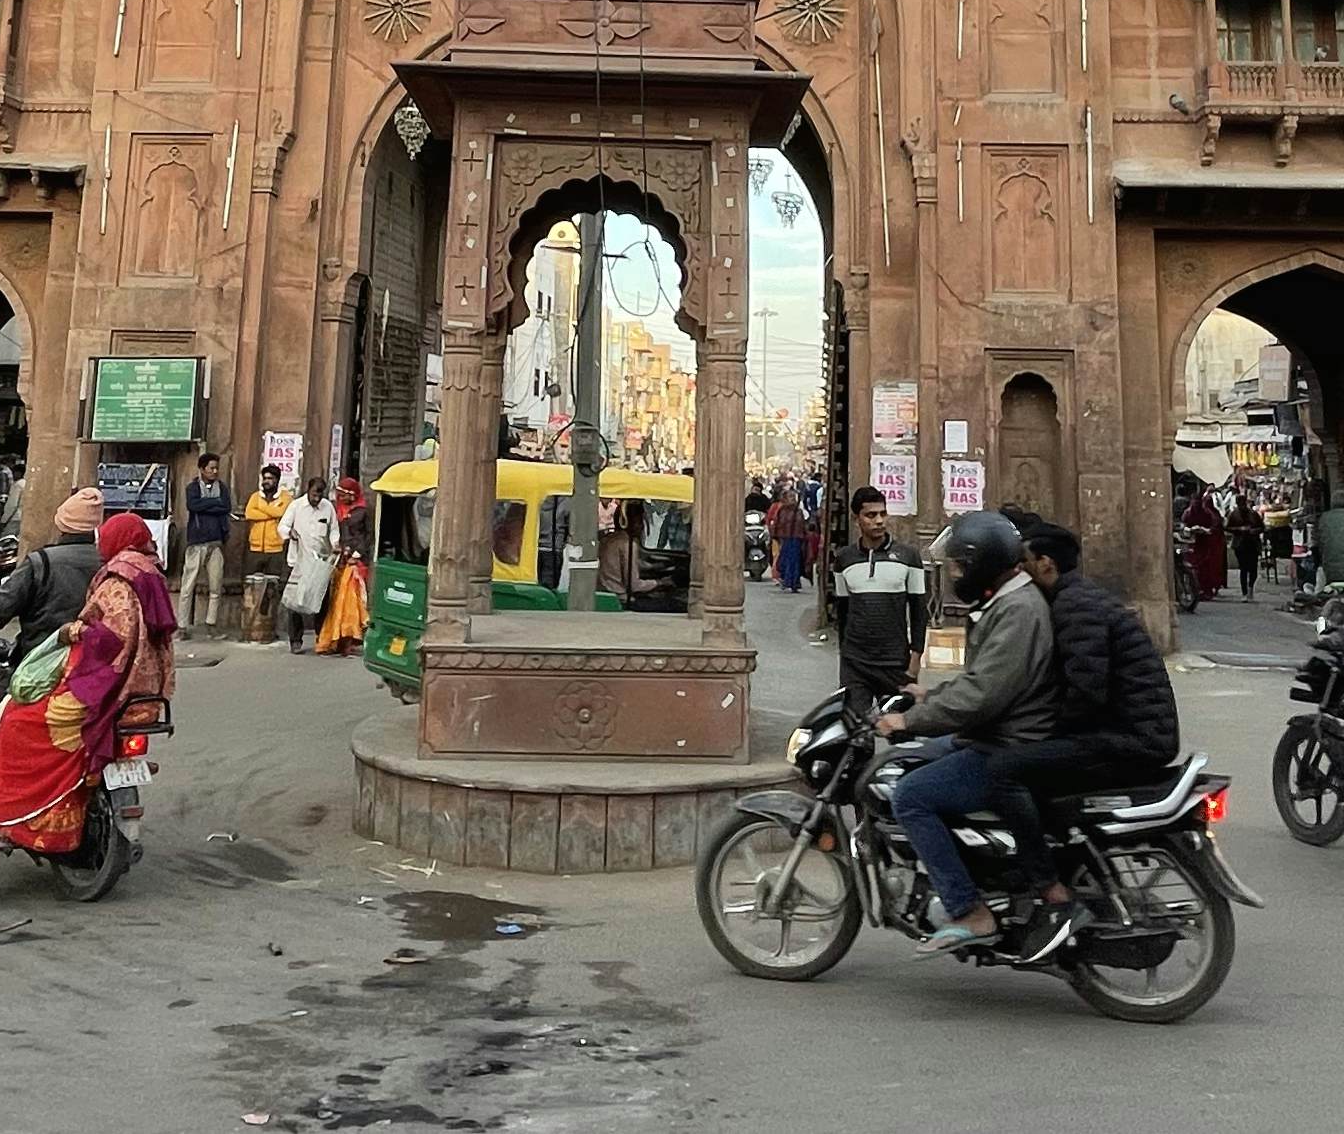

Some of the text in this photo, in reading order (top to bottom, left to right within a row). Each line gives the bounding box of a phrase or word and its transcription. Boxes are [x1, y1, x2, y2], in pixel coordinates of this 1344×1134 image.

[268, 447, 295, 458] IAS
[268, 462, 294, 473] AS
[878, 474, 906, 486] IAS
[949, 476, 978, 489] IAS
[949, 492, 978, 504] RAS
